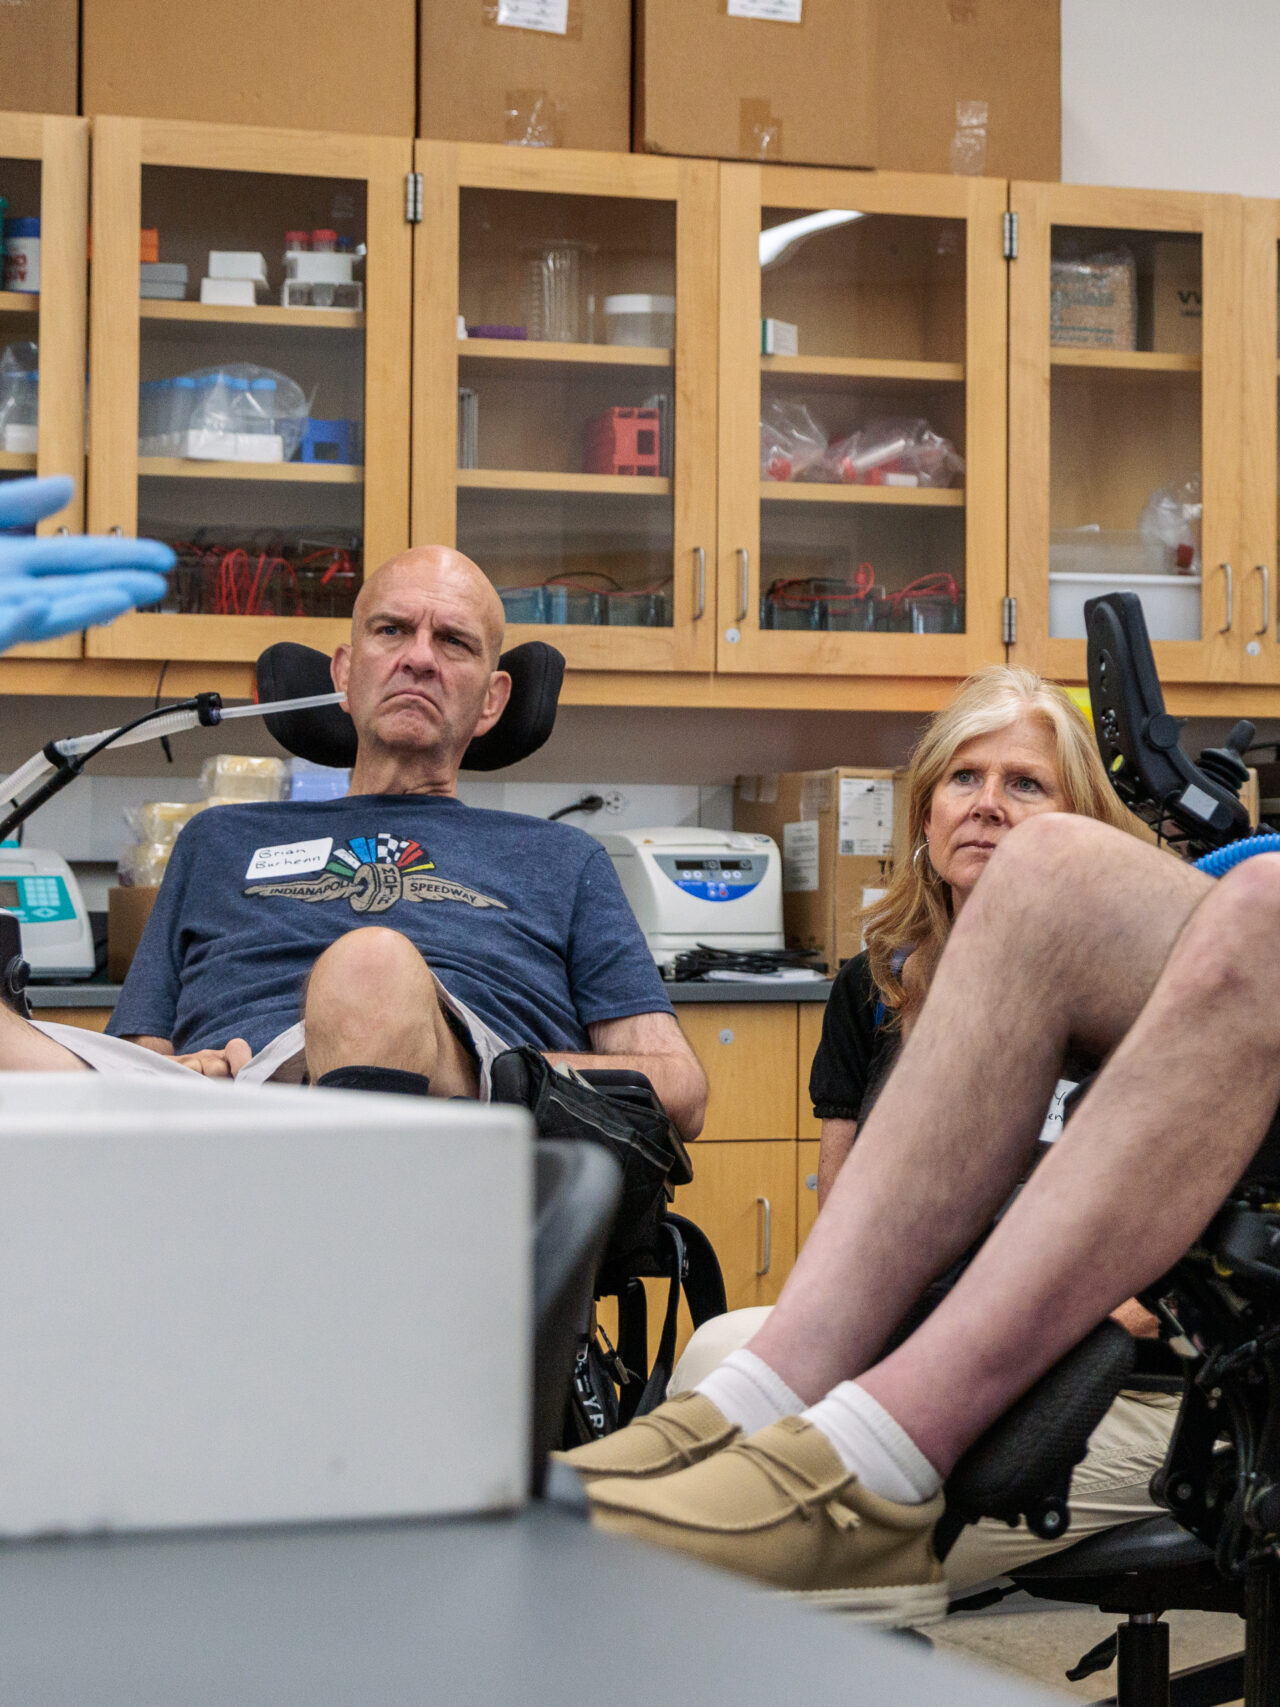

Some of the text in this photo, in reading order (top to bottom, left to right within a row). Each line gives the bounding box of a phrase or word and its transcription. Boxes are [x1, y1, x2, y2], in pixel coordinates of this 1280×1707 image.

[259, 849, 306, 859] Brian
[269, 880, 350, 896] INDIANAPOLI
[410, 882, 477, 904] SPEEDWAY
